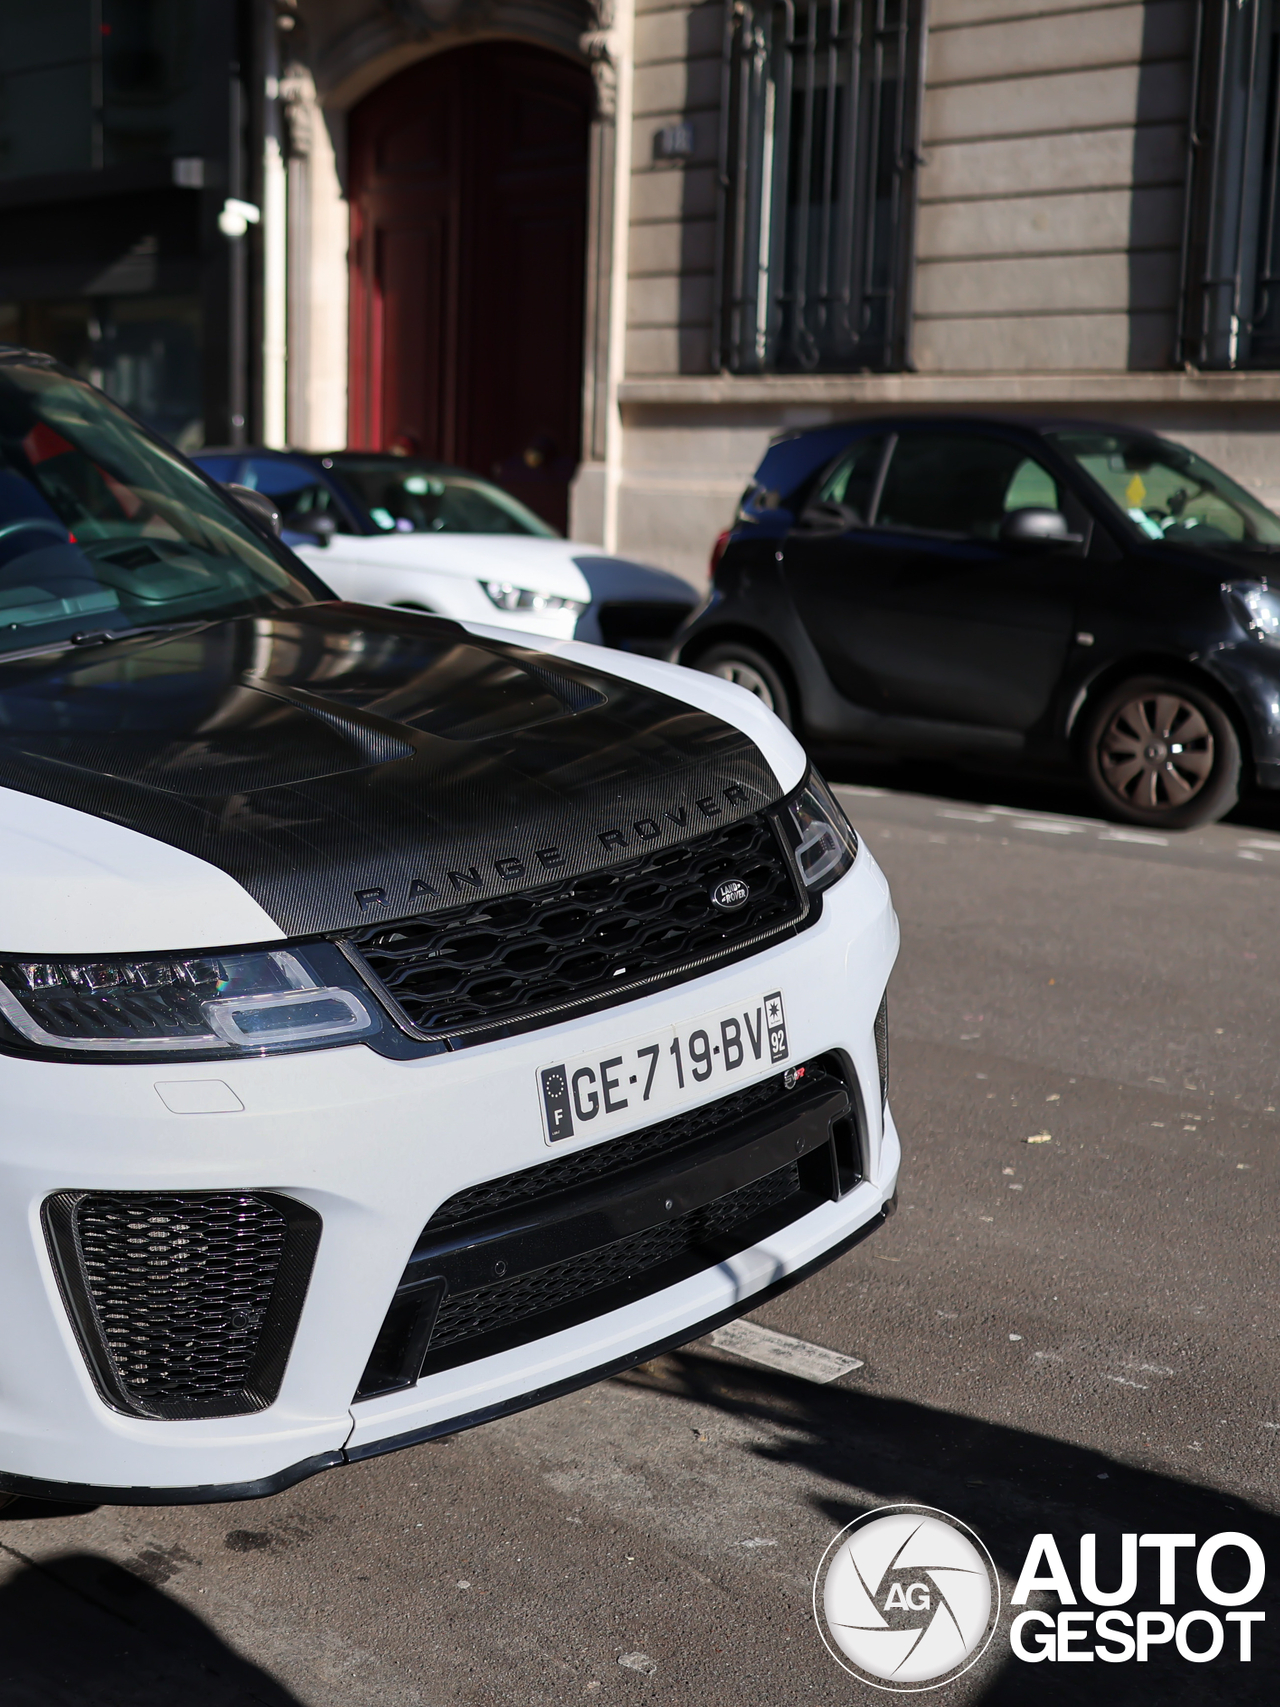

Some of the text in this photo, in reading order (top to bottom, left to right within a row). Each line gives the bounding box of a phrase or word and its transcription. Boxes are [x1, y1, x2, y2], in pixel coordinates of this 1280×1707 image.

[354, 785, 749, 912] RANGE ROVER
[720, 883, 738, 896] LAND
[725, 889, 746, 904] ROVER
[771, 1029, 786, 1053] 92
[571, 1007, 762, 1122] GE-719-BV
[554, 1108, 563, 1126] F
